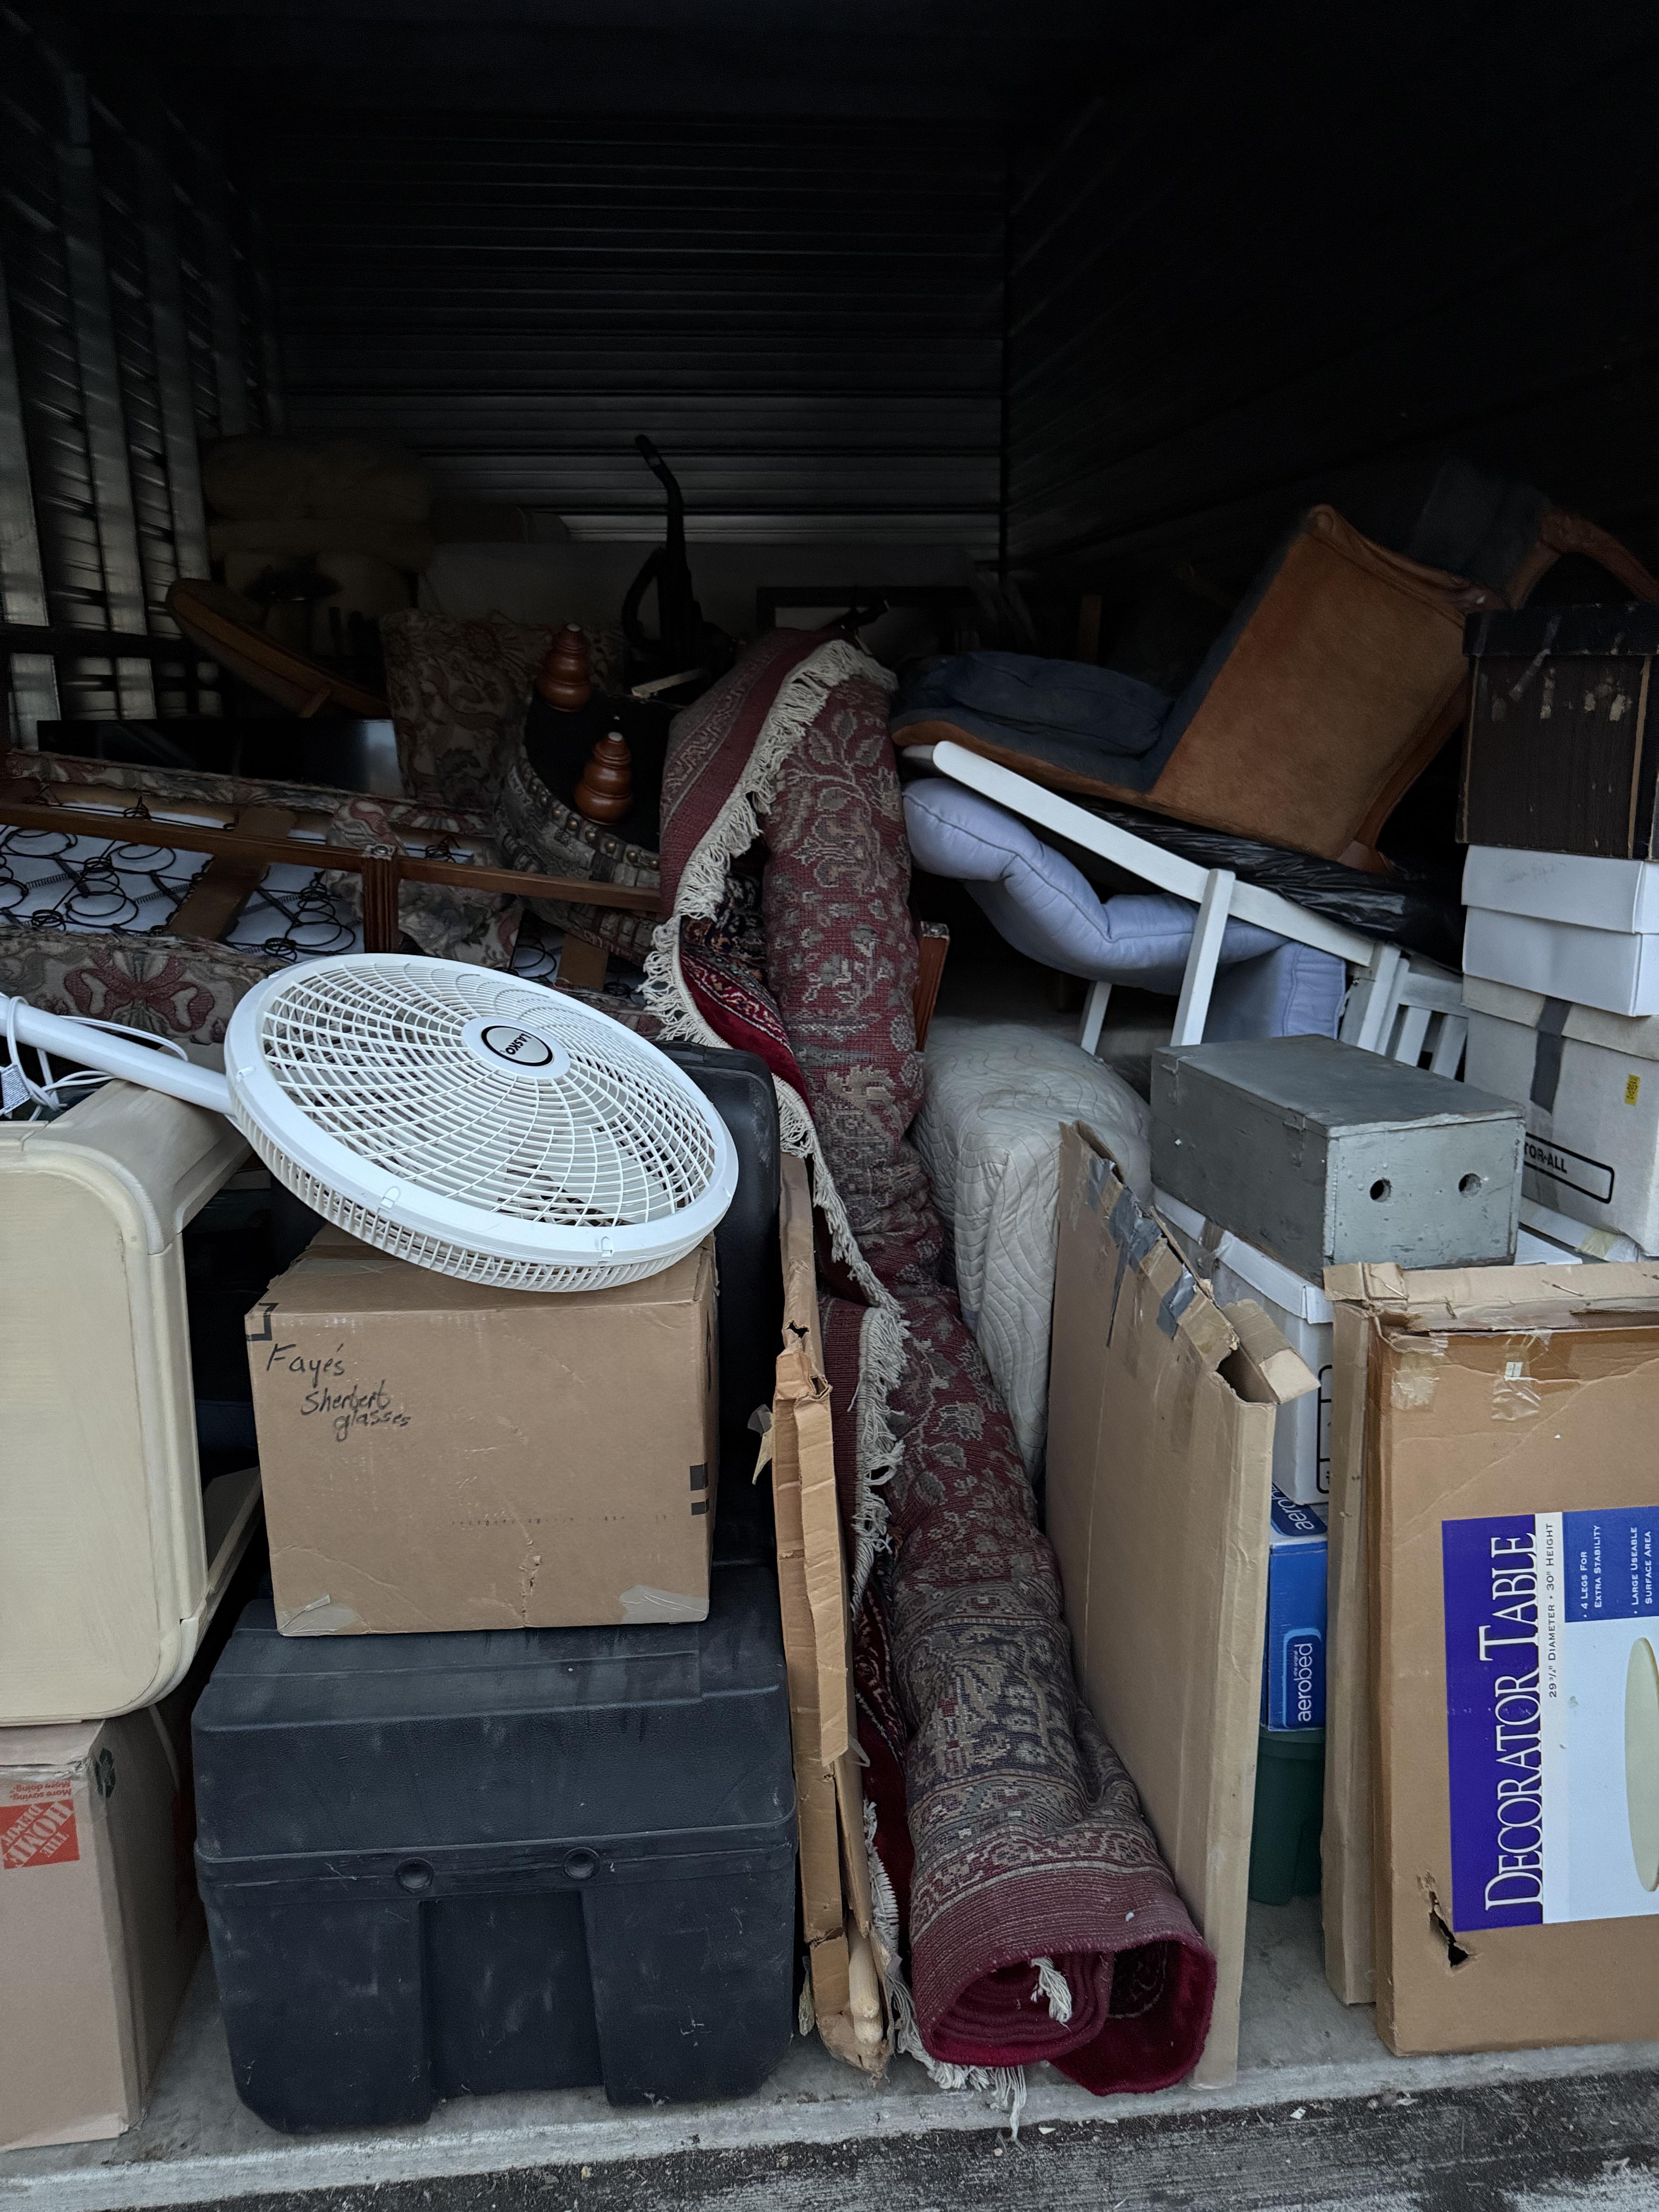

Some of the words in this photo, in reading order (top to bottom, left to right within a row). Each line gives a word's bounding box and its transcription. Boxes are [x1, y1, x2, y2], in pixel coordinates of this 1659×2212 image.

[505, 1033, 532, 1055] LASKO
[334, 1408, 412, 1443] glasses
[1546, 1523, 1554, 1566] HEIGHT
[1478, 1532, 1540, 1661] TABLE
[1594, 1577, 1602, 1608] EXTRA
[1631, 1574, 1639, 1605] LARGE
[1645, 1560, 1653, 1604] SURFACE
[1546, 1604, 1556, 1661] DIAMETER
[1293, 1643, 1312, 1722] aerobed
[1547, 1682, 1557, 1698] 29
[46, 1789, 72, 1797] More
[1484, 1667, 1543, 1911] DECORATOR
[5, 1802, 75, 1867] HOME
[40, 1832, 69, 1857] THE
